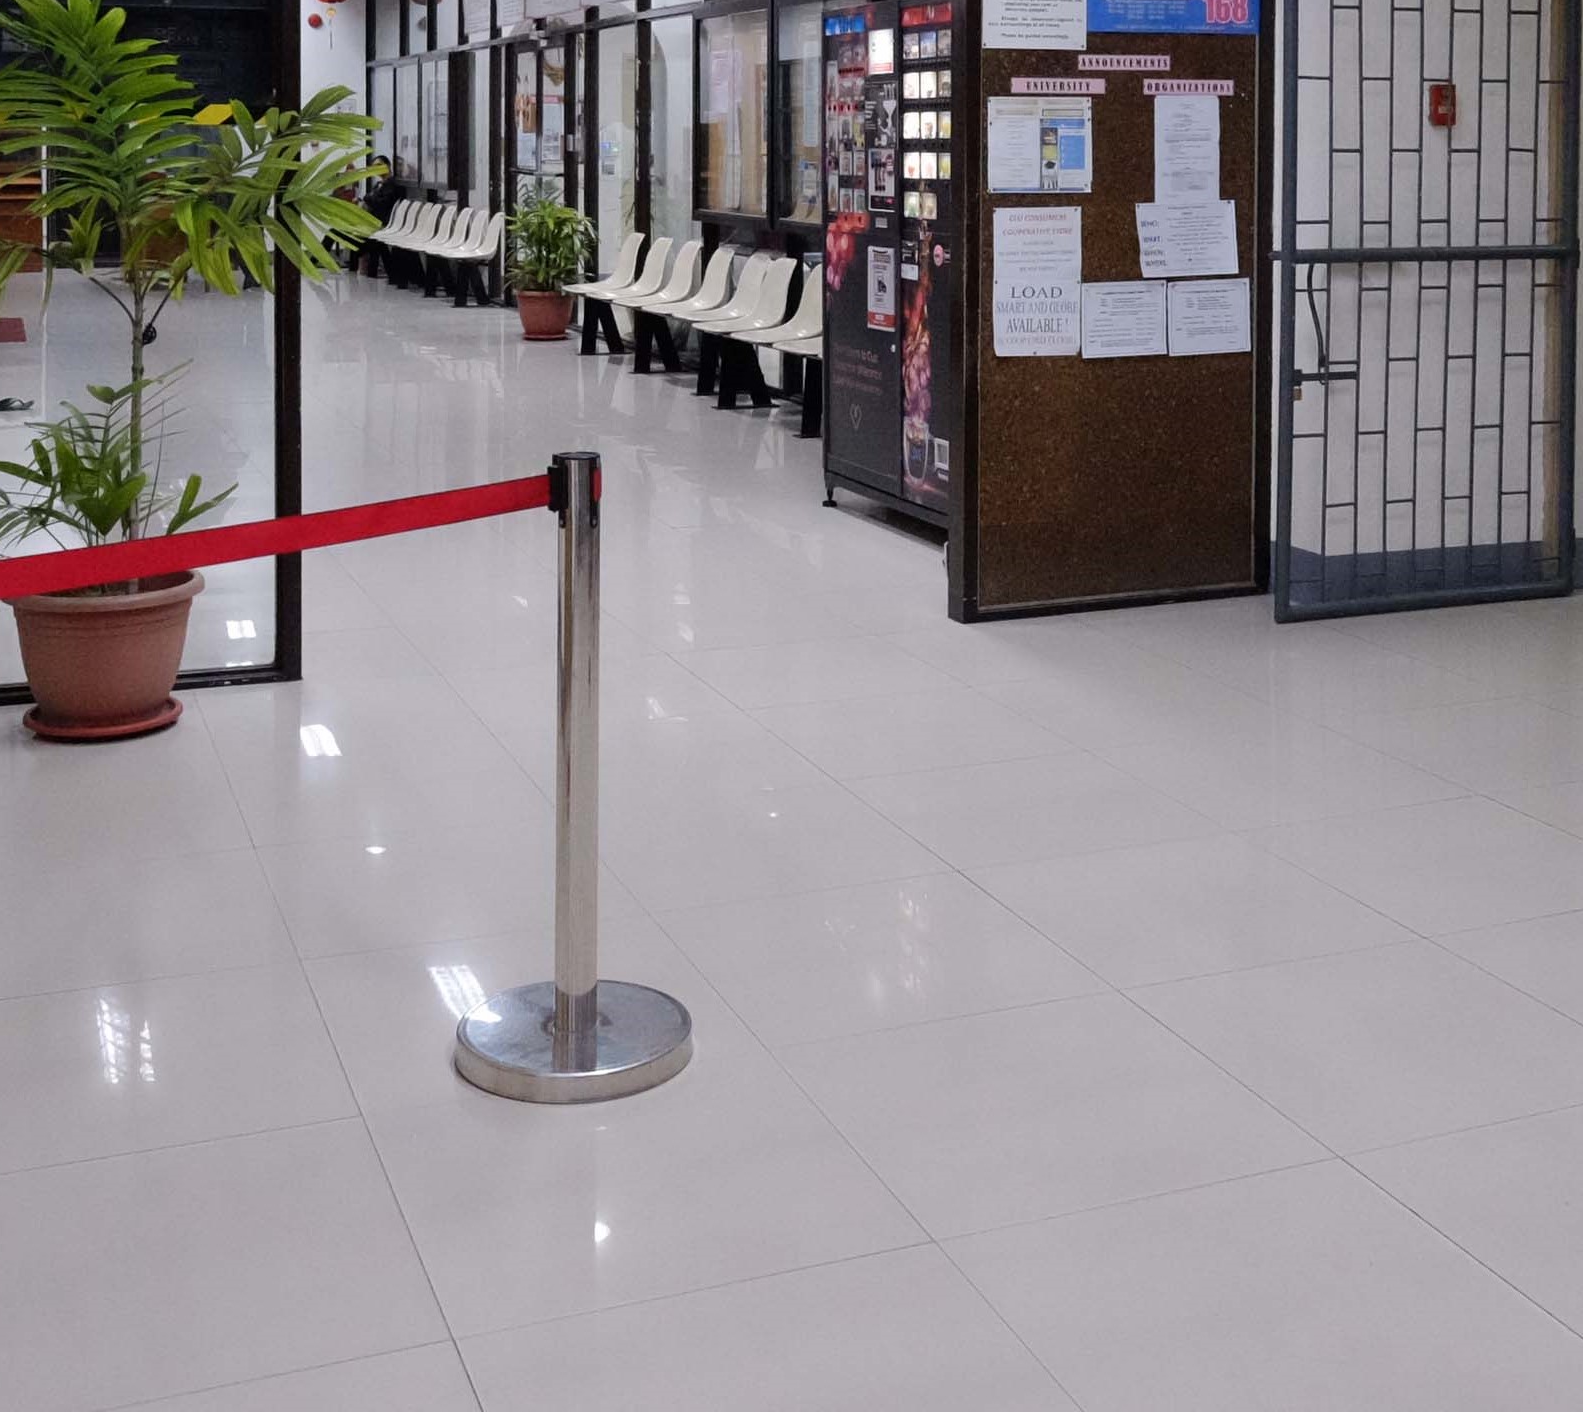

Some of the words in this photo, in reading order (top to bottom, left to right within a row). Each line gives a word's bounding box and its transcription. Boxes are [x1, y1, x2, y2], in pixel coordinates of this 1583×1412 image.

[1079, 54, 1169, 69] ANNOUNCEMENTS
[1025, 80, 1092, 92] UNIVERSITY
[1011, 286, 1063, 299] LOAD
